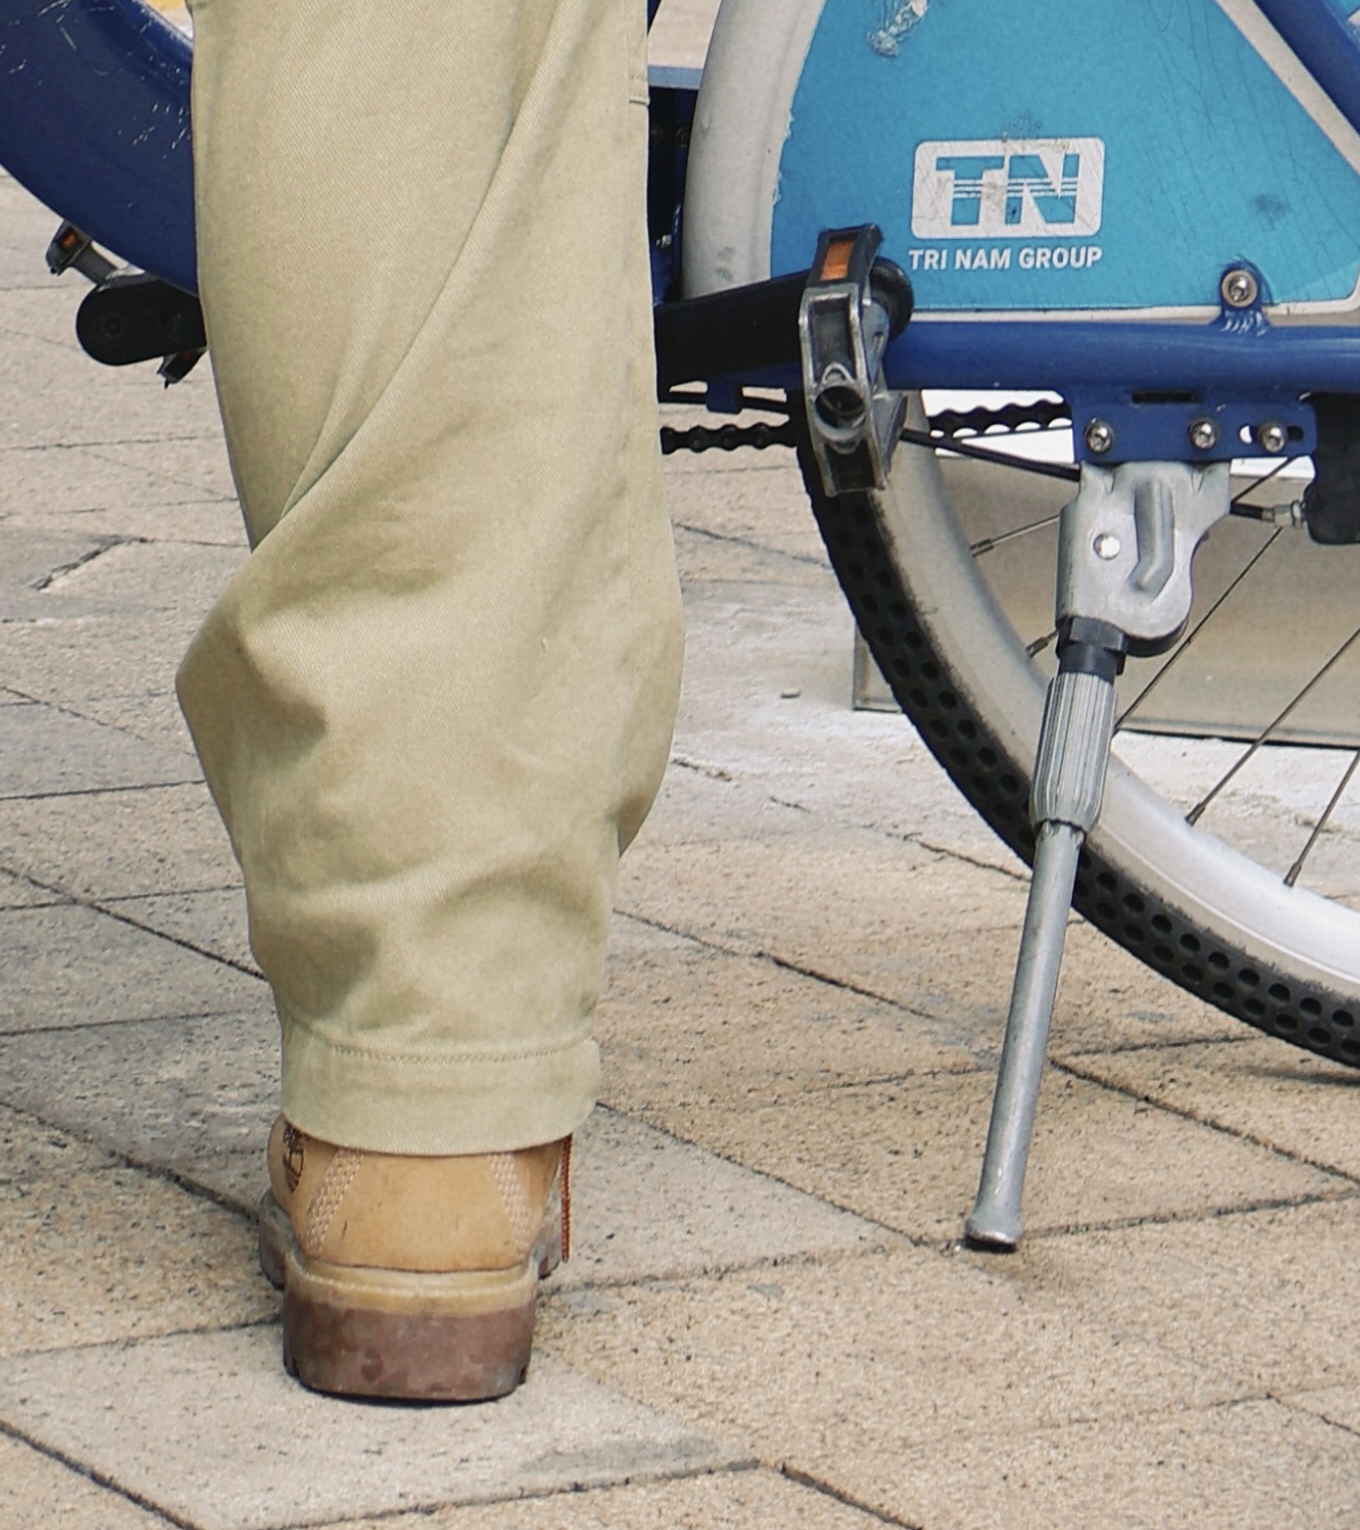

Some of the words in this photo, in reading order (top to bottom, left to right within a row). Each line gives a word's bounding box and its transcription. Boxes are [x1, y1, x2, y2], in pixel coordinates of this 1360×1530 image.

[936, 153, 1081, 227] TN
[908, 248, 948, 271] TRI
[954, 247, 1012, 271] NAM
[1018, 245, 1103, 270] GROUP
